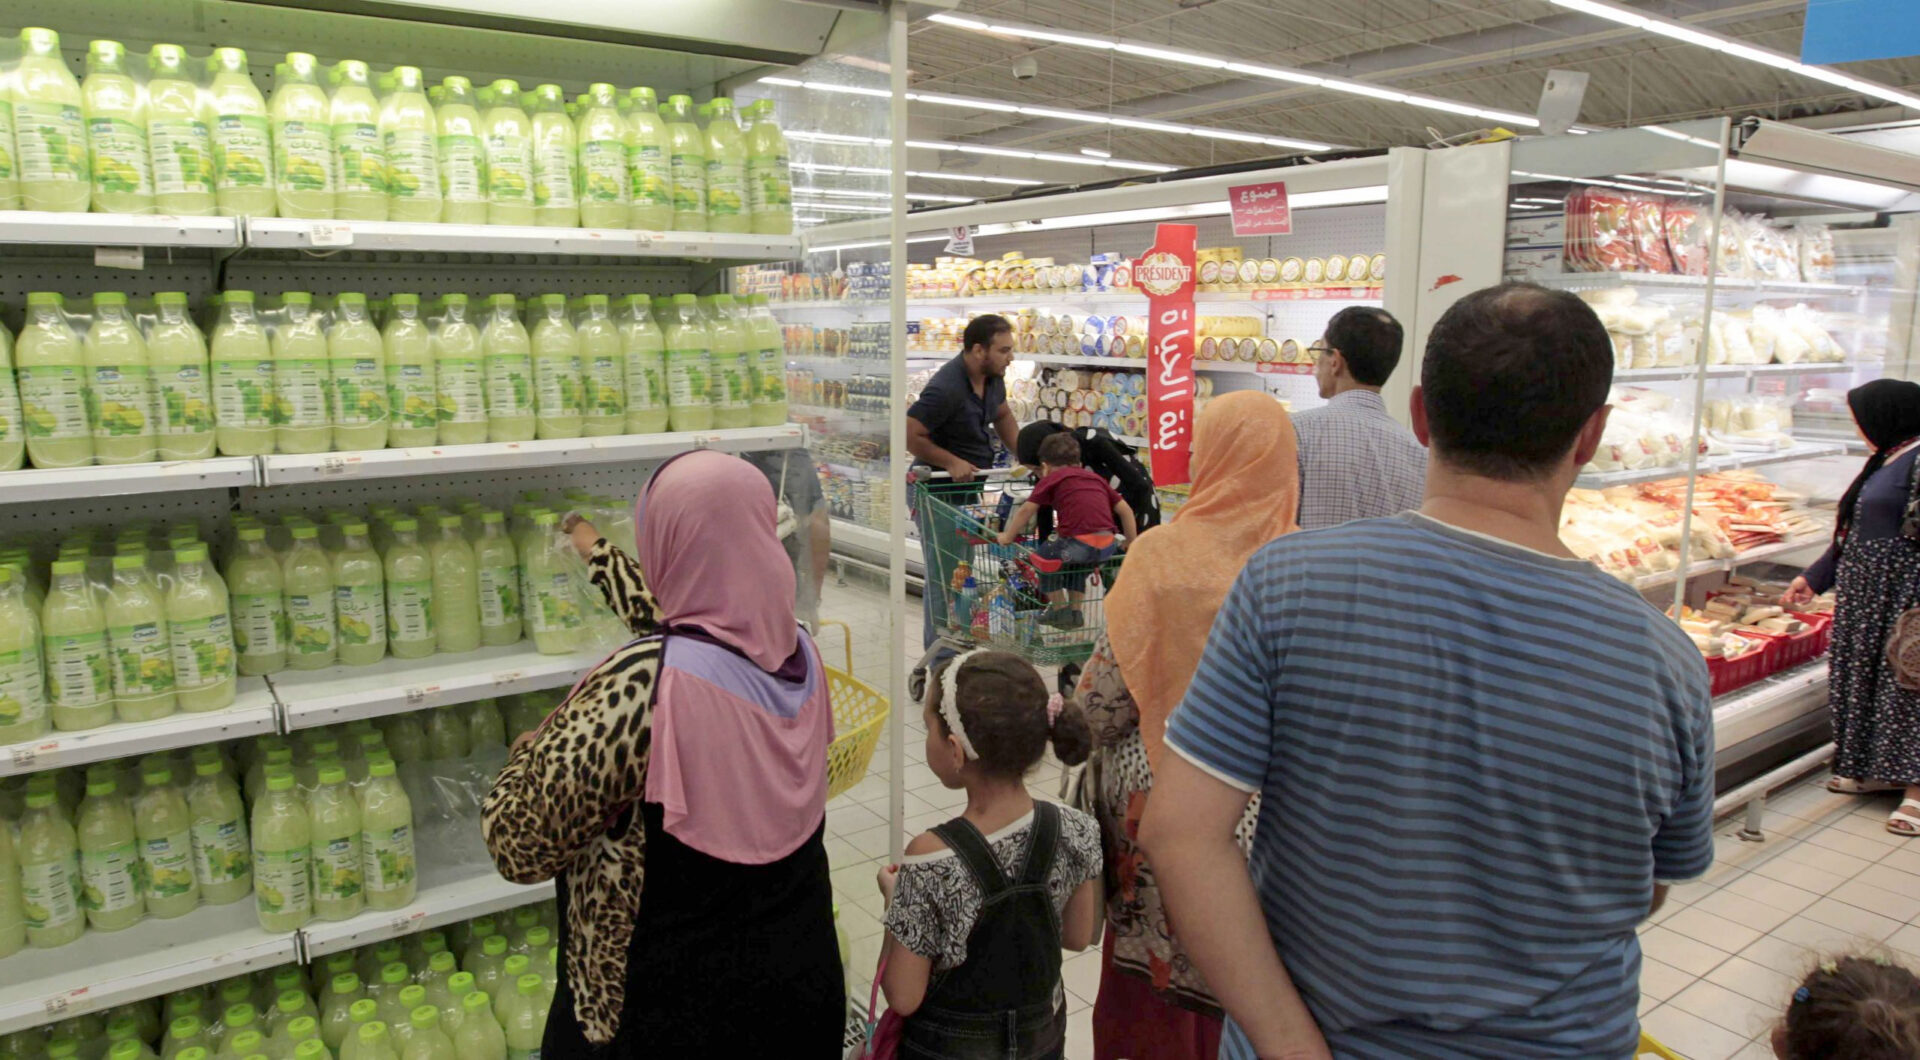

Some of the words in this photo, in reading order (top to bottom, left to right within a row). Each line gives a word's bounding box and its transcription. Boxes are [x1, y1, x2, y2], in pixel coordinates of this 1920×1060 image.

[1240, 186, 1278, 204] ممنوع
[1136, 263, 1191, 281] PRÉSIDENT
[1154, 309, 1190, 401] الحياة
[1153, 409, 1185, 451] بنة
